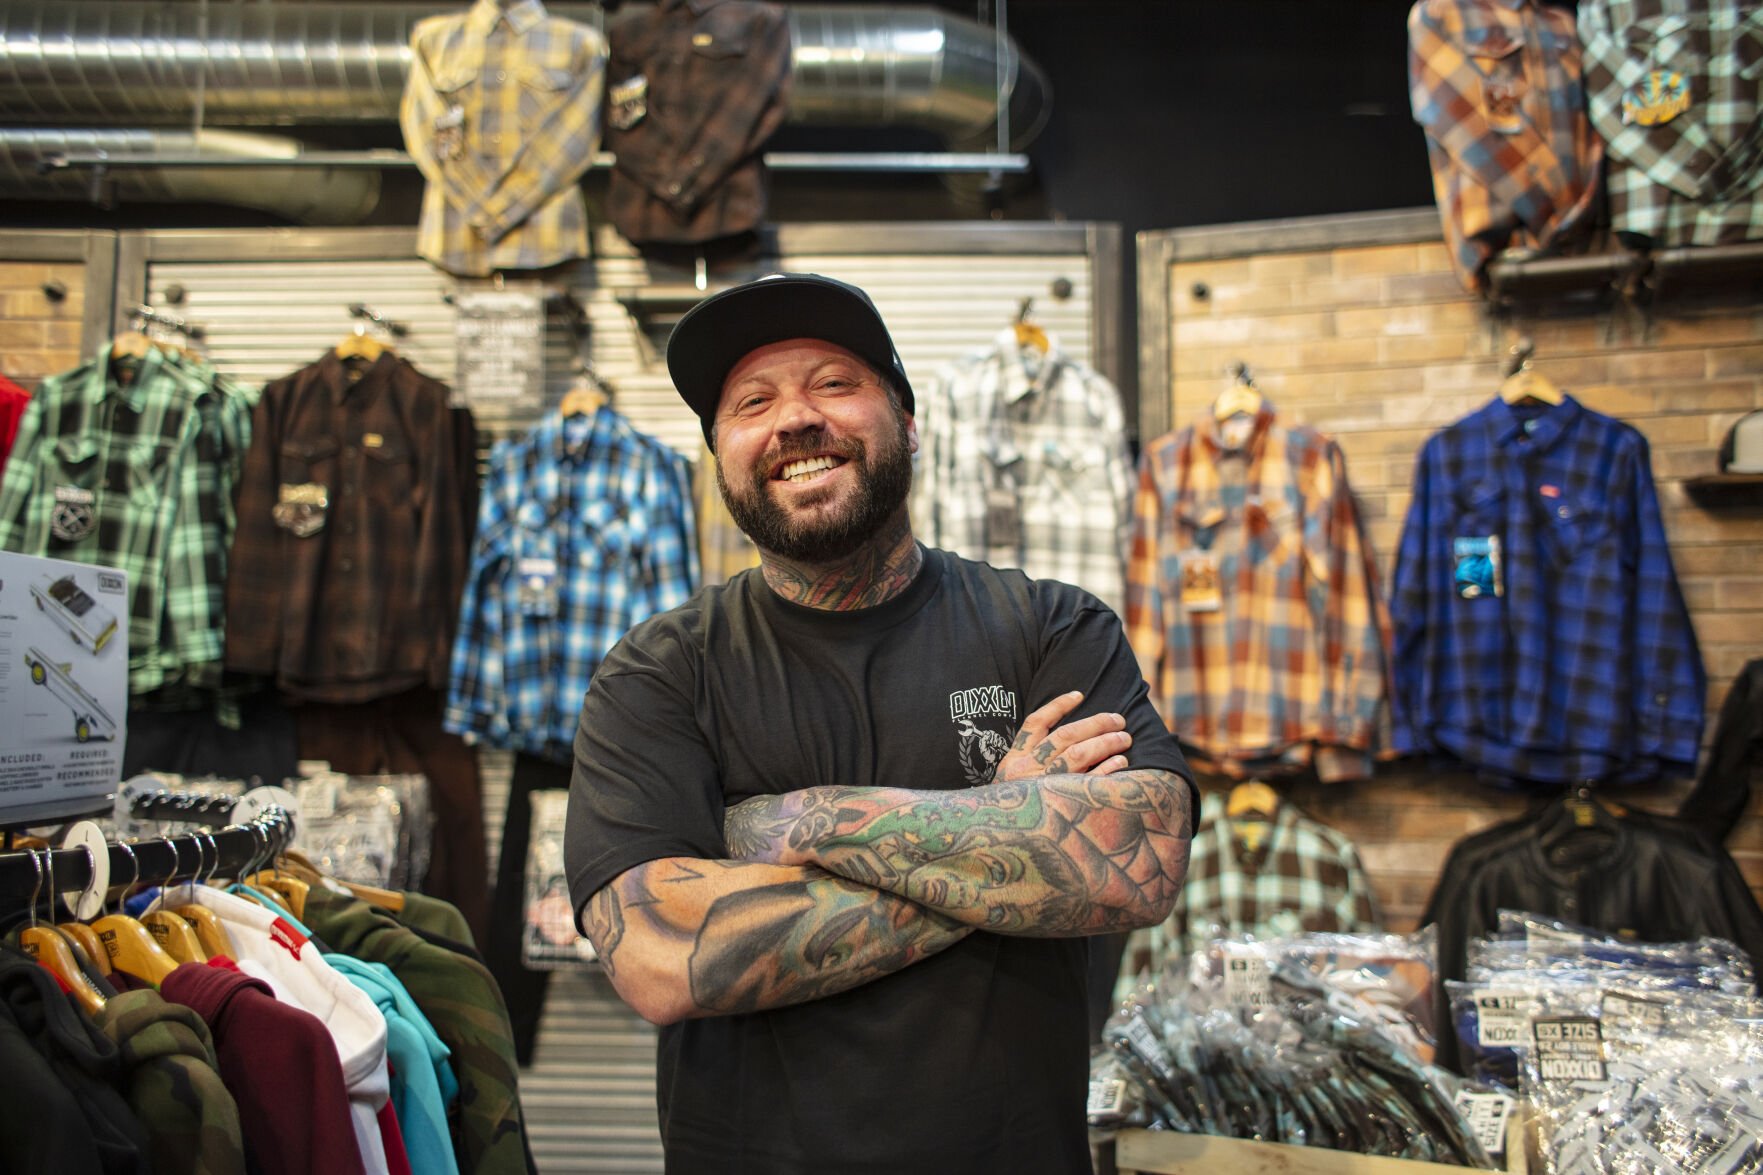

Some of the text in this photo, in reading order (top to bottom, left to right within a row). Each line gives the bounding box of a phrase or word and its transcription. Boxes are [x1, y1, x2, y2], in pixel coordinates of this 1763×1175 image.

[0, 753, 45, 764] NCLUDED:
[1562, 1023, 1599, 1040] SIZE
[1541, 1059, 1601, 1080] DIXXON
